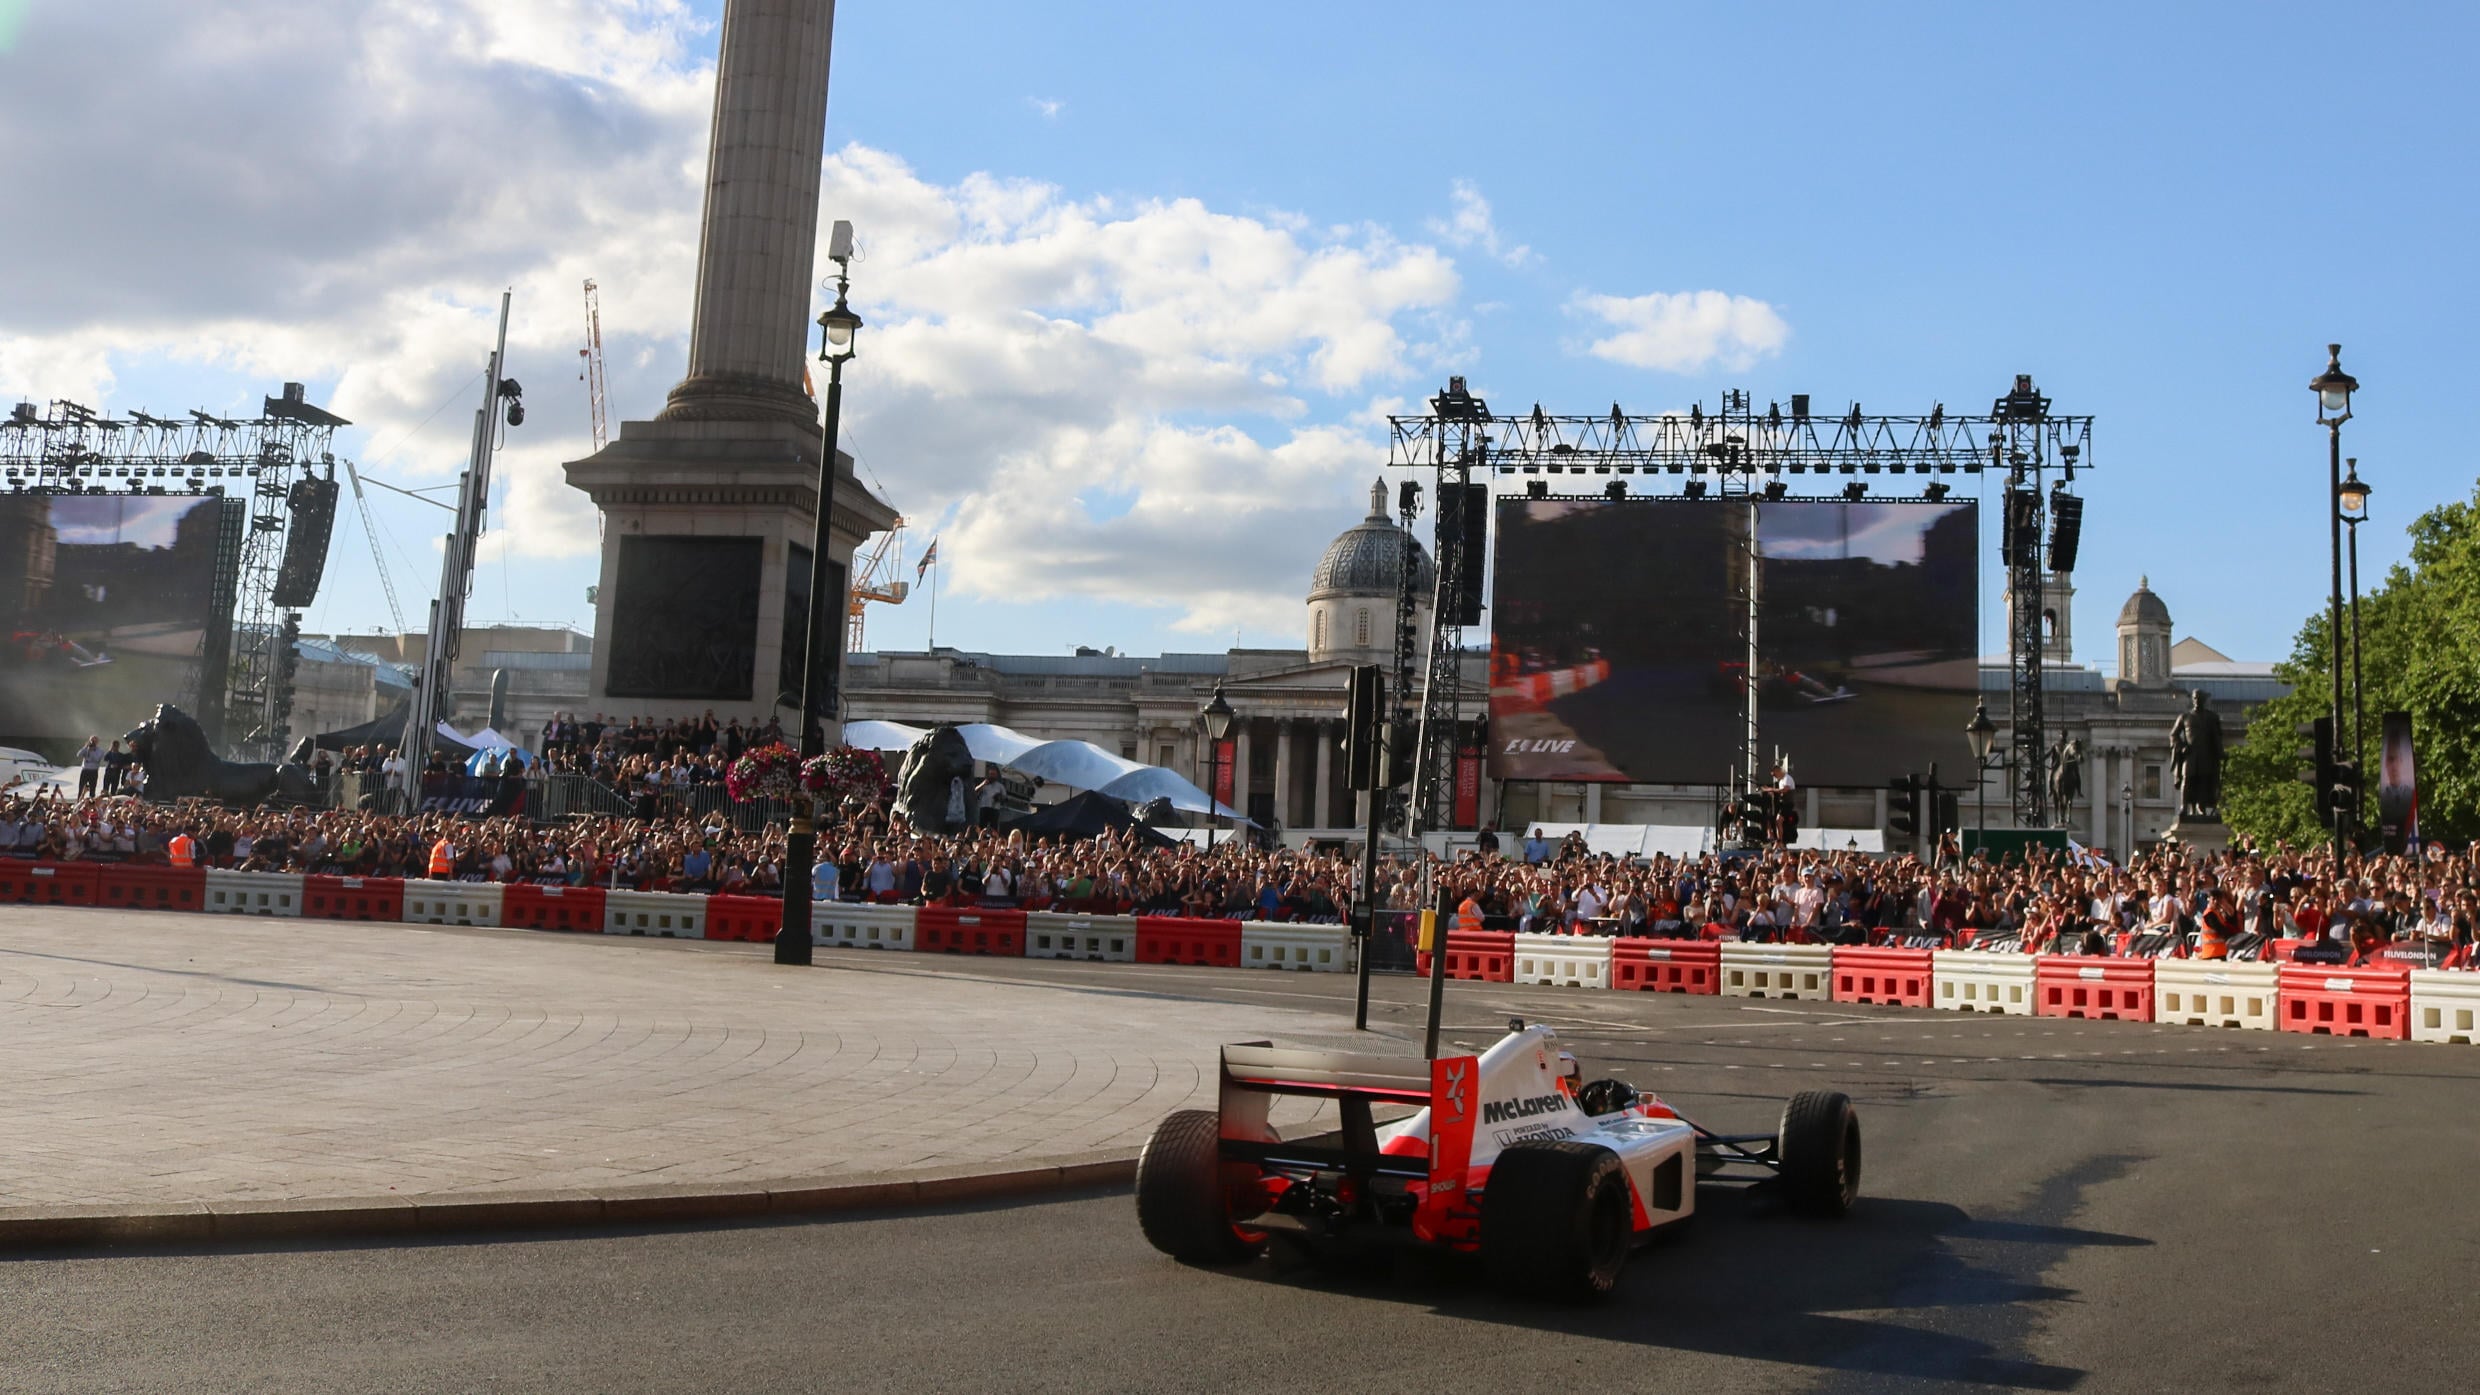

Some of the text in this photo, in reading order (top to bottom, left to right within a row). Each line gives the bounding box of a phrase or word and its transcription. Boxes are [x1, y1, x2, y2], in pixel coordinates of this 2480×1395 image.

[1531, 739, 1576, 753] LIVE
[1904, 936, 1942, 949] LIVE
[1989, 939, 2023, 953] LIVE
[1484, 1093, 1568, 1125] McLaren
[1431, 1133, 1440, 1171] 1
